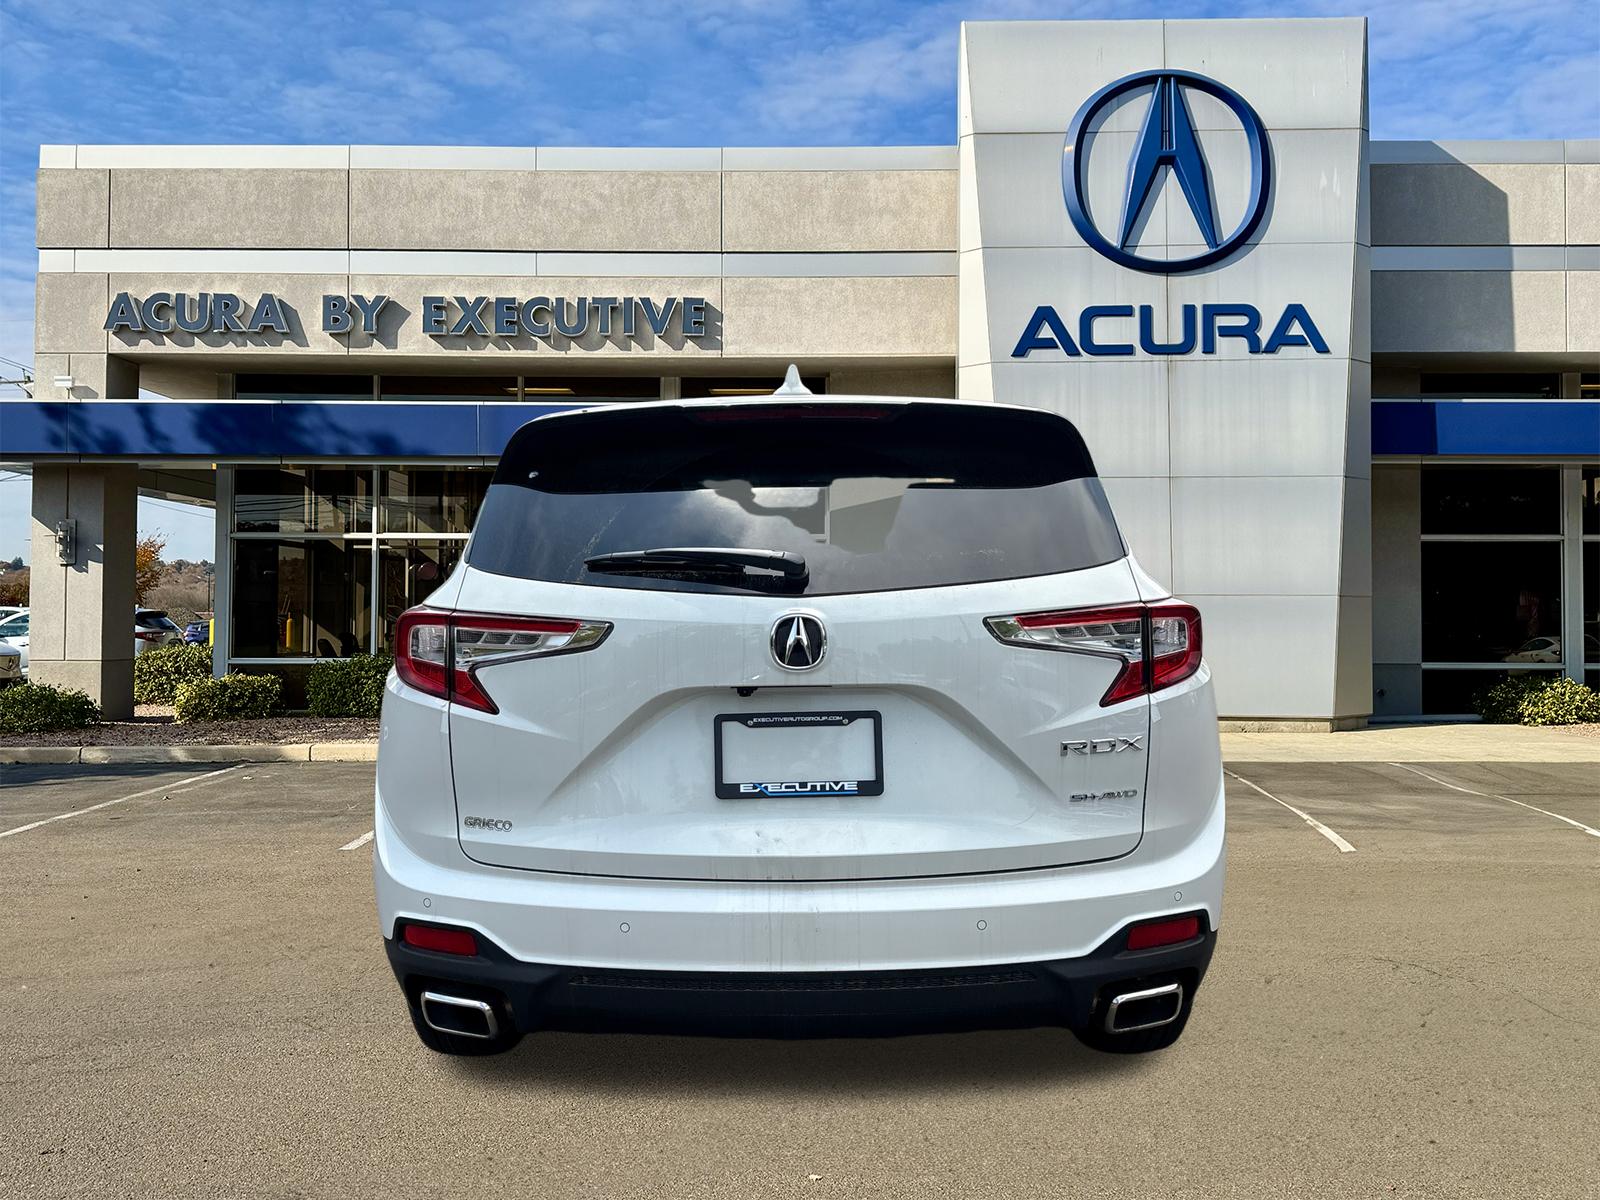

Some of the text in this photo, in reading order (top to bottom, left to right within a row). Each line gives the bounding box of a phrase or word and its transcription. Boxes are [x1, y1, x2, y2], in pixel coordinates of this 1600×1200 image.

[104, 291, 709, 338] ACURA BY EXECUTIVE
[1011, 303, 1332, 358] ACURA
[1060, 735, 1143, 756] RDX
[739, 781, 859, 796] EXECUTIVE
[464, 816, 513, 833] GRIECO
